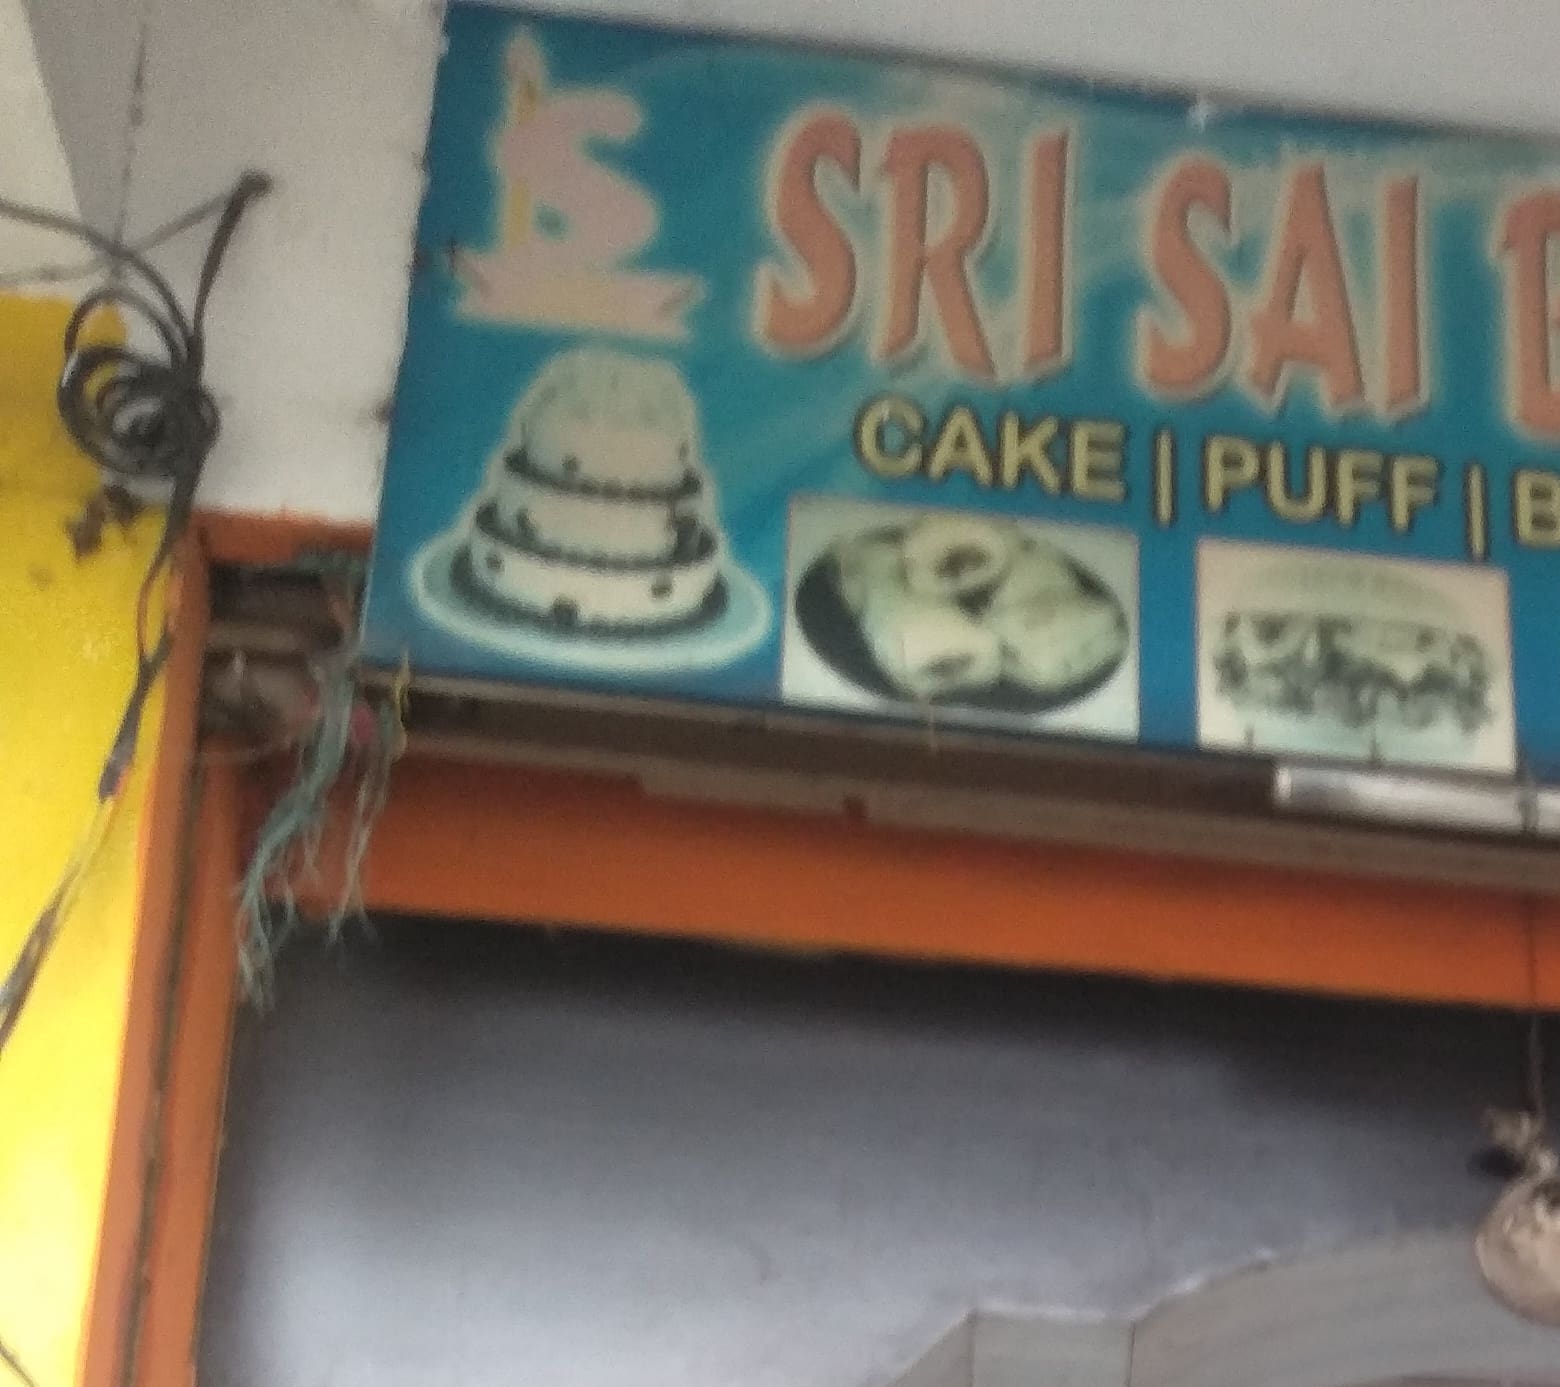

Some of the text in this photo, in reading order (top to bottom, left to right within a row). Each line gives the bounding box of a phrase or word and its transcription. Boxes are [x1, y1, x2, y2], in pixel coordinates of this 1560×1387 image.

[758, 110, 1072, 382] SRI
[1140, 152, 1428, 418] SAI
[855, 398, 1126, 502] CAKE
[1202, 432, 1440, 532] PUFF
